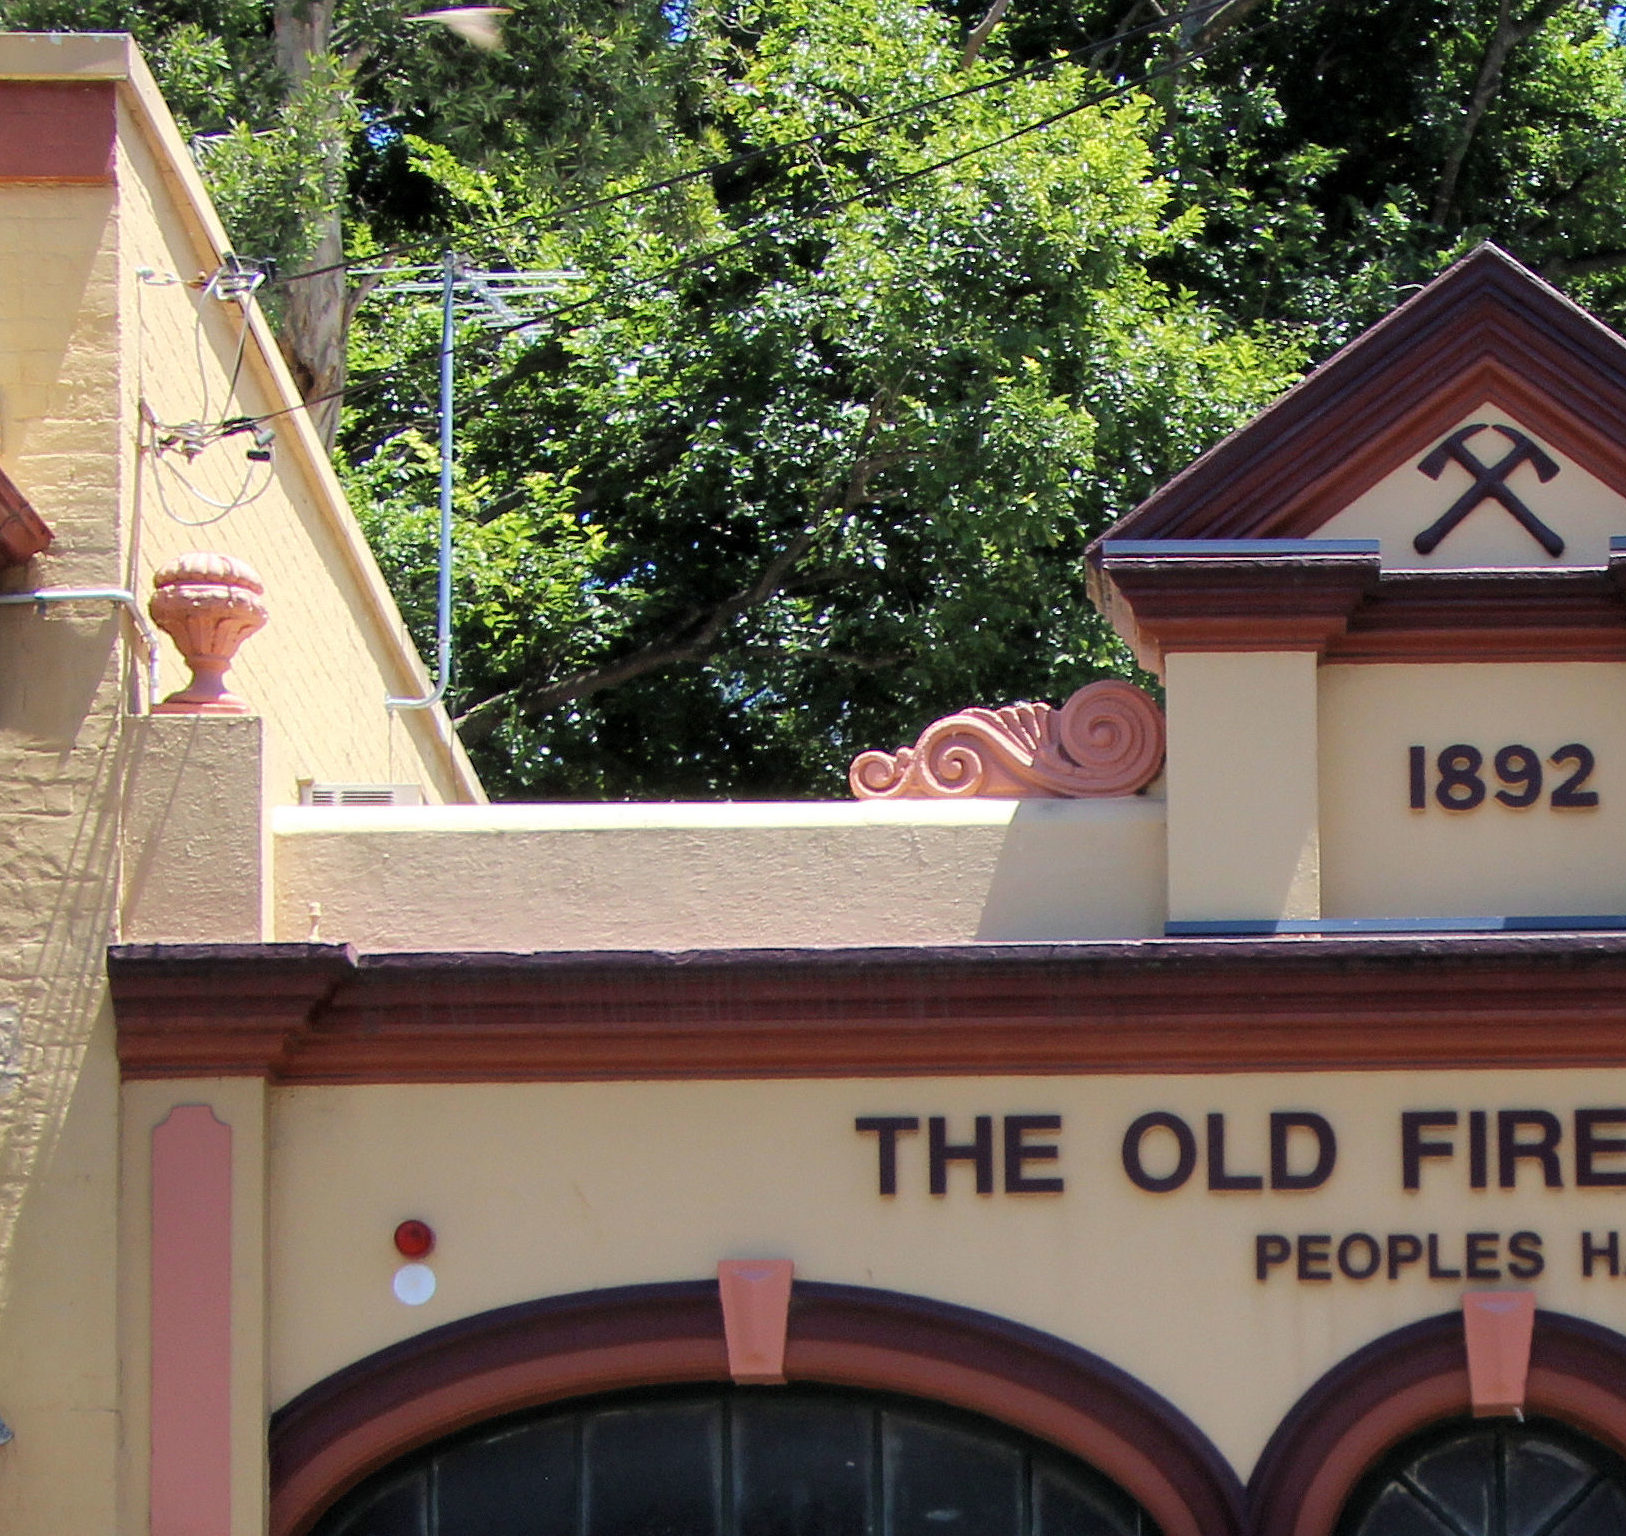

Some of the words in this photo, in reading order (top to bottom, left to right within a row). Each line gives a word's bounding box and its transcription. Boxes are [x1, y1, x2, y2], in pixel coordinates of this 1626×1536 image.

[1410, 743, 1599, 811] 1892
[855, 1114, 1065, 1196] THE
[1121, 1110, 1338, 1194] OLD
[1256, 1231, 1546, 1281] PEOPLES
